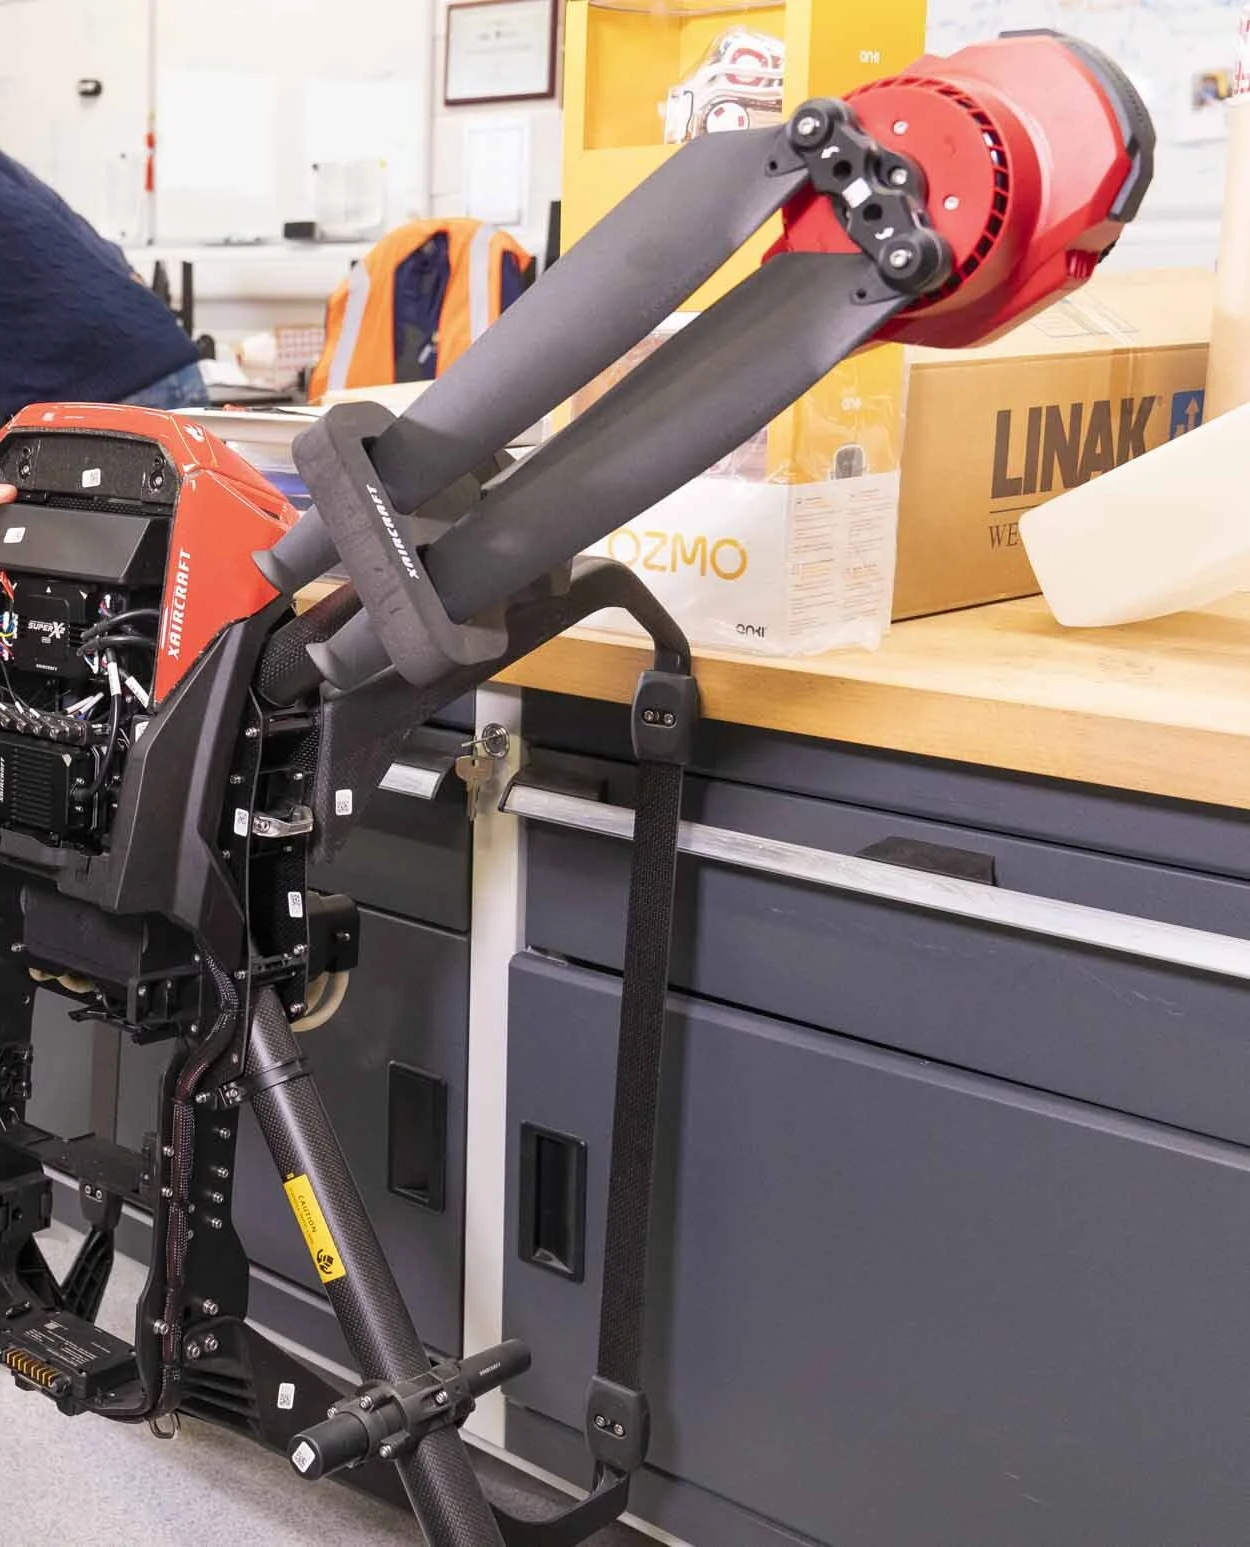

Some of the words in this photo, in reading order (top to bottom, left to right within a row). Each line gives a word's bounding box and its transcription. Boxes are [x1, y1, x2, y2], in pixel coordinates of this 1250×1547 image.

[990, 395, 1156, 499] LINAK
[366, 484, 420, 579] XAIRCRAFT
[607, 527, 748, 581] OZMO
[988, 522, 1018, 549] WE
[167, 547, 191, 660] XAIRCRAFT
[297, 1194, 318, 1233] CAUTION
